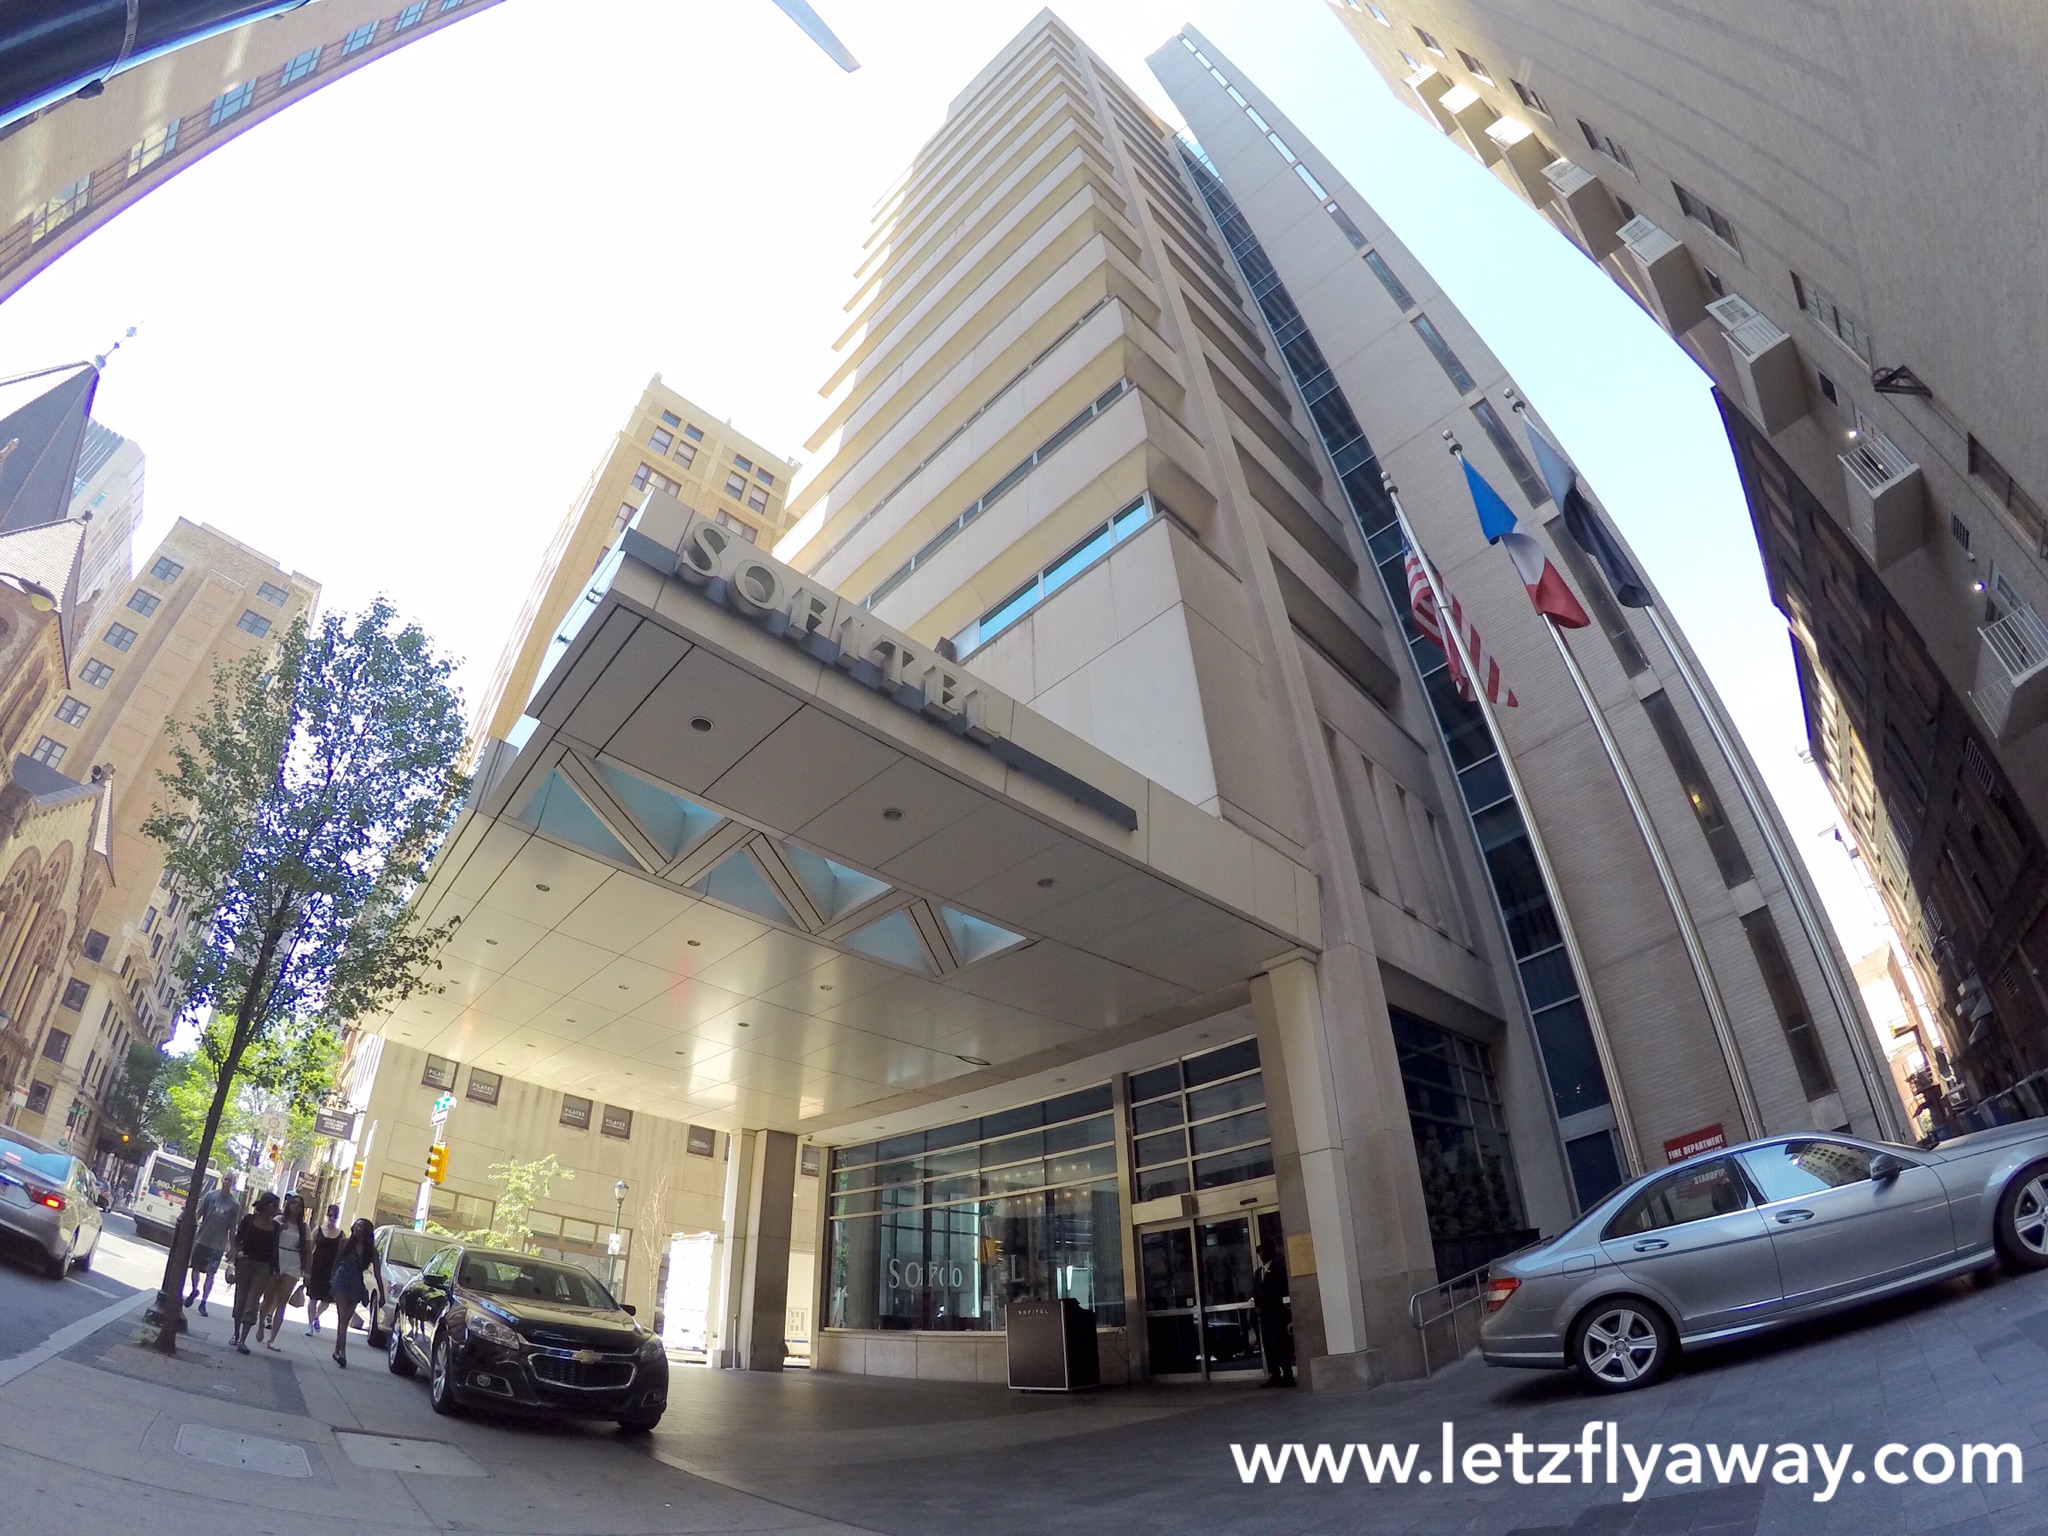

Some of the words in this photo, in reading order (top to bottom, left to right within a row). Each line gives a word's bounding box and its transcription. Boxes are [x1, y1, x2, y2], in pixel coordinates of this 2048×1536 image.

[676, 520, 1001, 740] SOFITEL
[472, 1082, 494, 1093] PILATES
[564, 1108, 585, 1118] PILATES
[606, 1118, 626, 1128] PILATES
[1668, 1147, 1682, 1160] FIRE
[1683, 1134, 1724, 1156] DEPARTMENT
